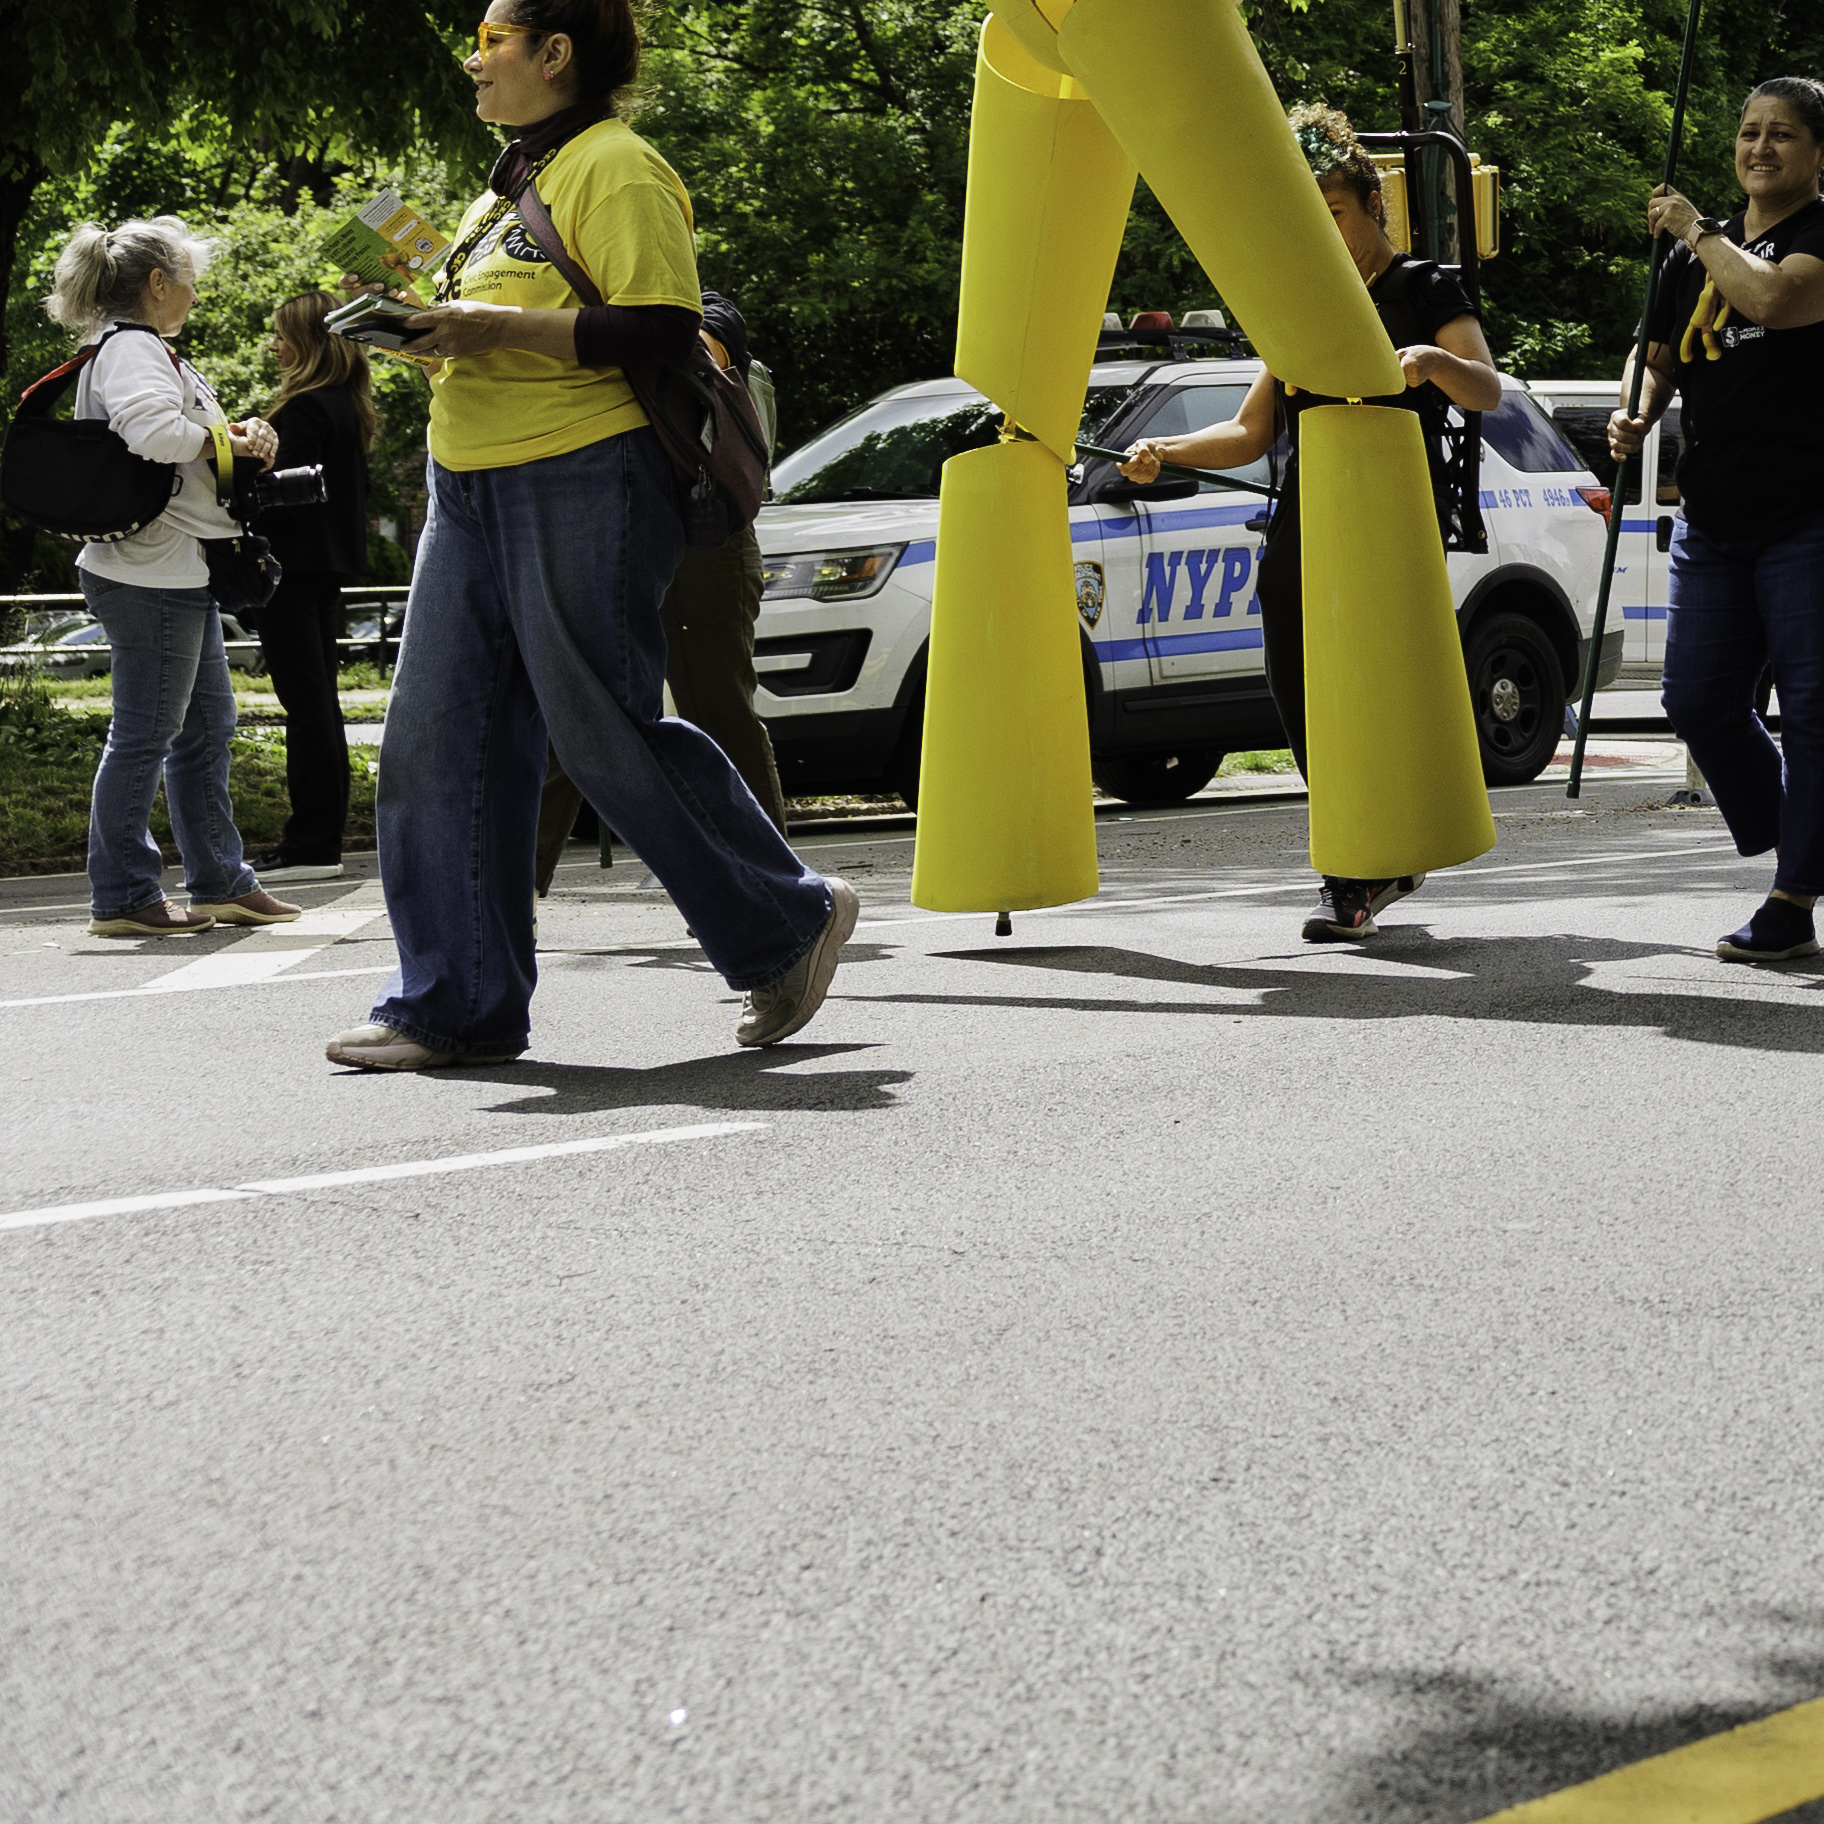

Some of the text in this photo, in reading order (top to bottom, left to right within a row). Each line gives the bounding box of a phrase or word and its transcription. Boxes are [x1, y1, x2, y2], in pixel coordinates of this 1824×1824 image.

[478, 270, 536, 281] Engagement
[463, 281, 502, 297] Commission
[1740, 331, 1765, 340] MONEY
[1512, 489, 1532, 508] PCT
